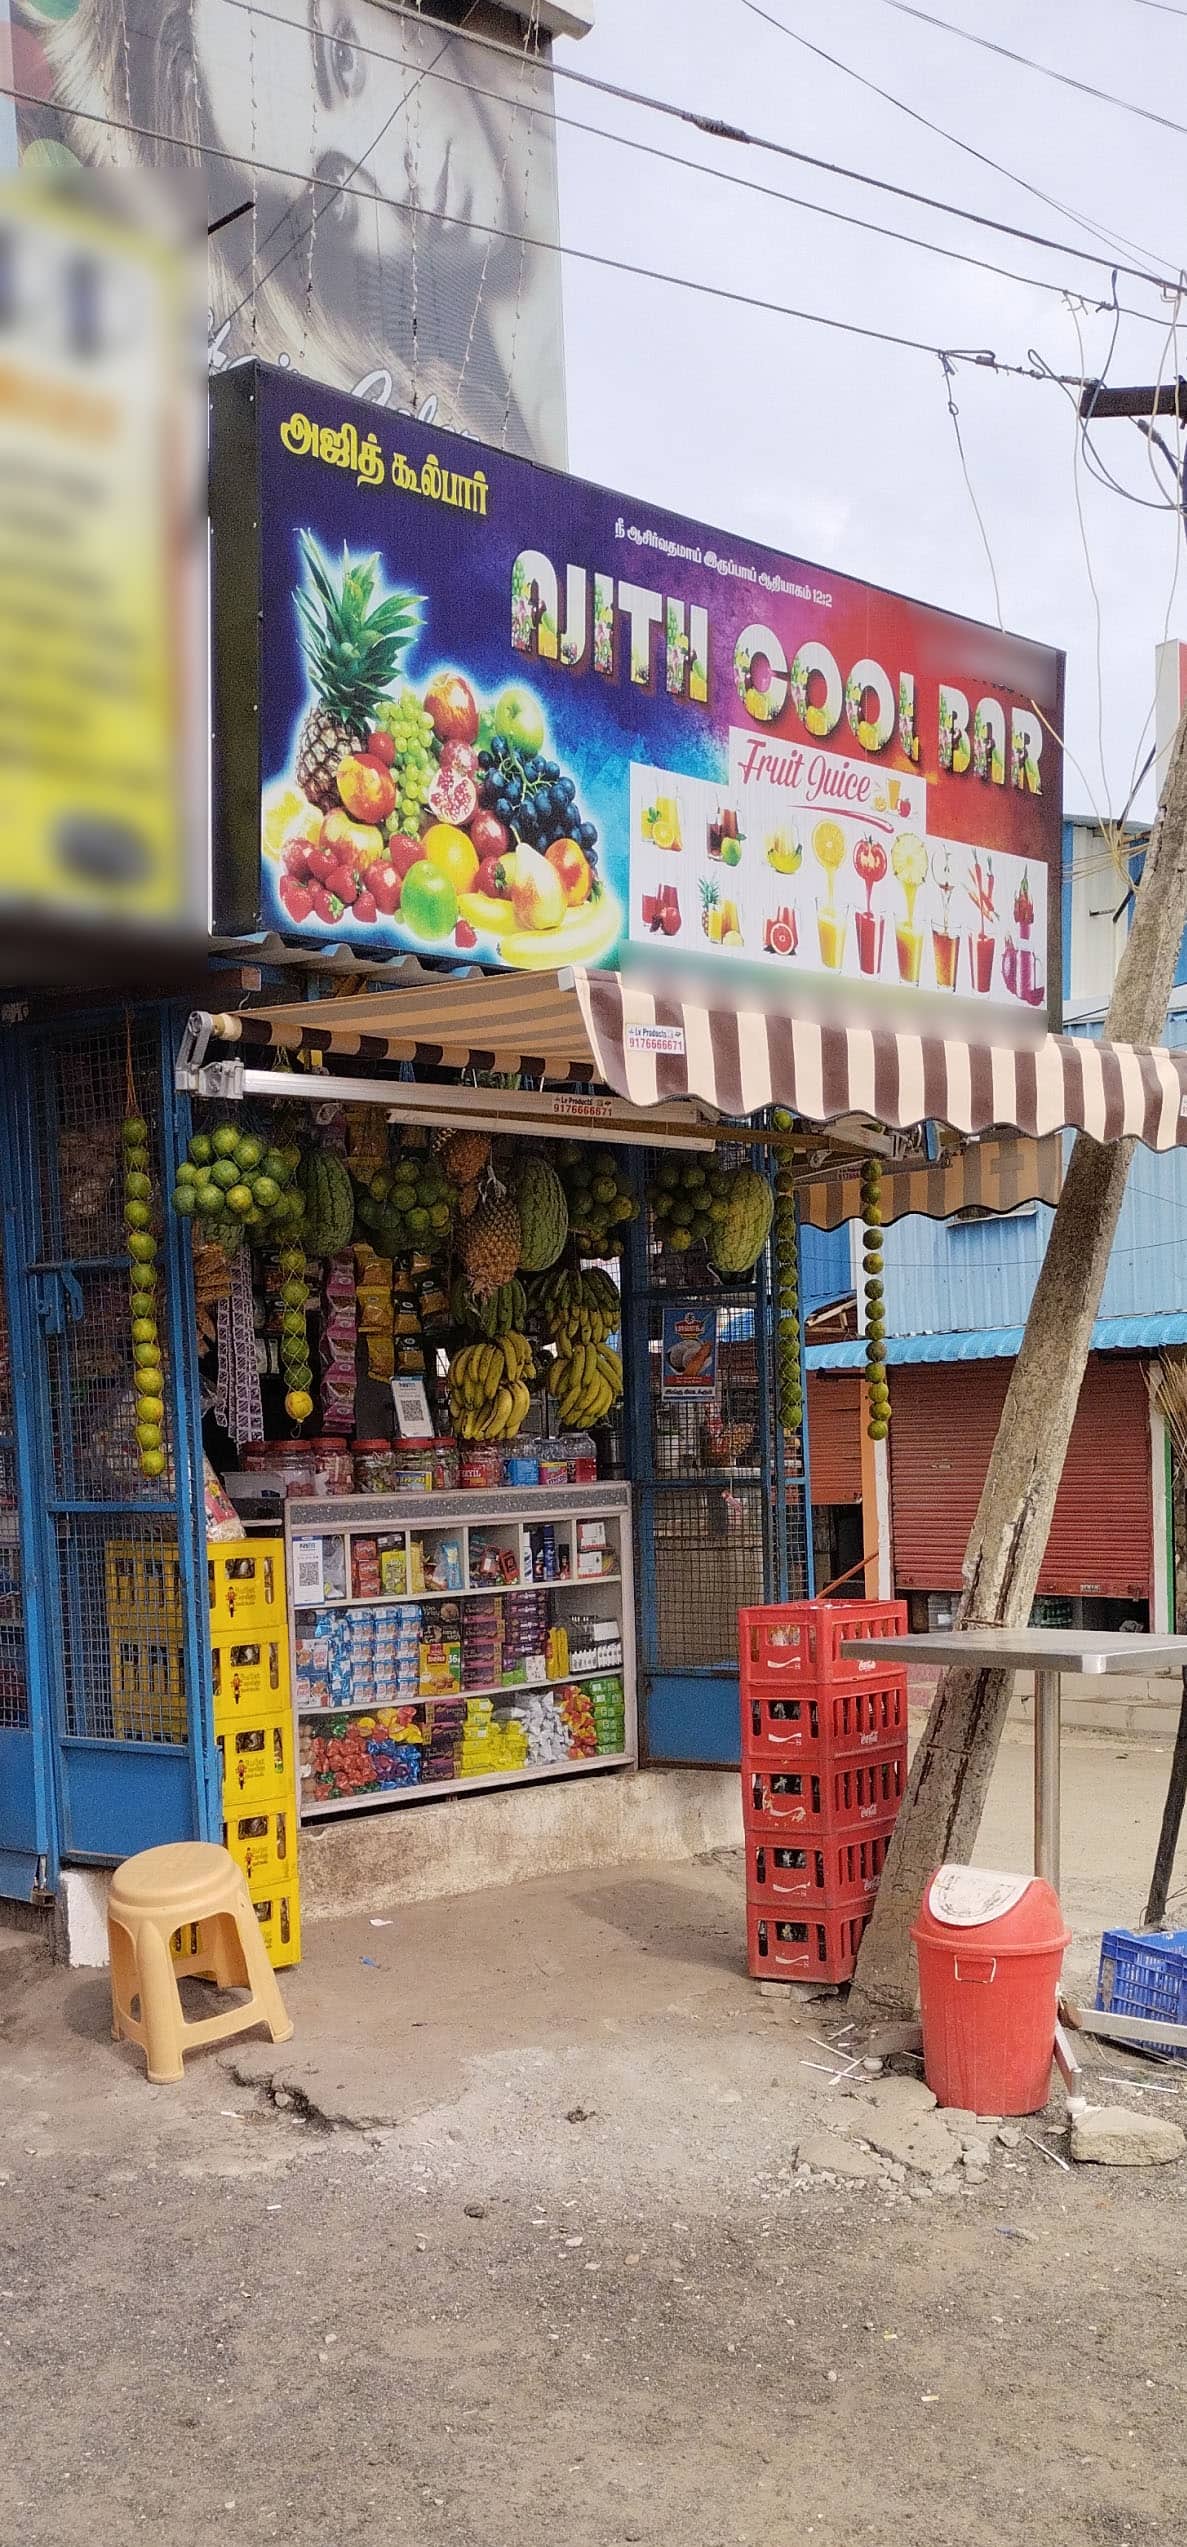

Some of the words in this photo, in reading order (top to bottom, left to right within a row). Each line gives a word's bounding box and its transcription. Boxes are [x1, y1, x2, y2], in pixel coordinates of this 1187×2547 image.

[280, 412, 385, 487] அஜித்
[391, 452, 489, 515] கூல்பார்
[511, 549, 709, 703] AJITH
[733, 623, 920, 762] COOL
[939, 683, 1044, 796] BAR
[737, 738, 806, 789] Fruit
[805, 754, 871, 803] Juice
[629, 1037, 683, 1051] 9176666671
[553, 1103, 612, 1117] 9176666671
